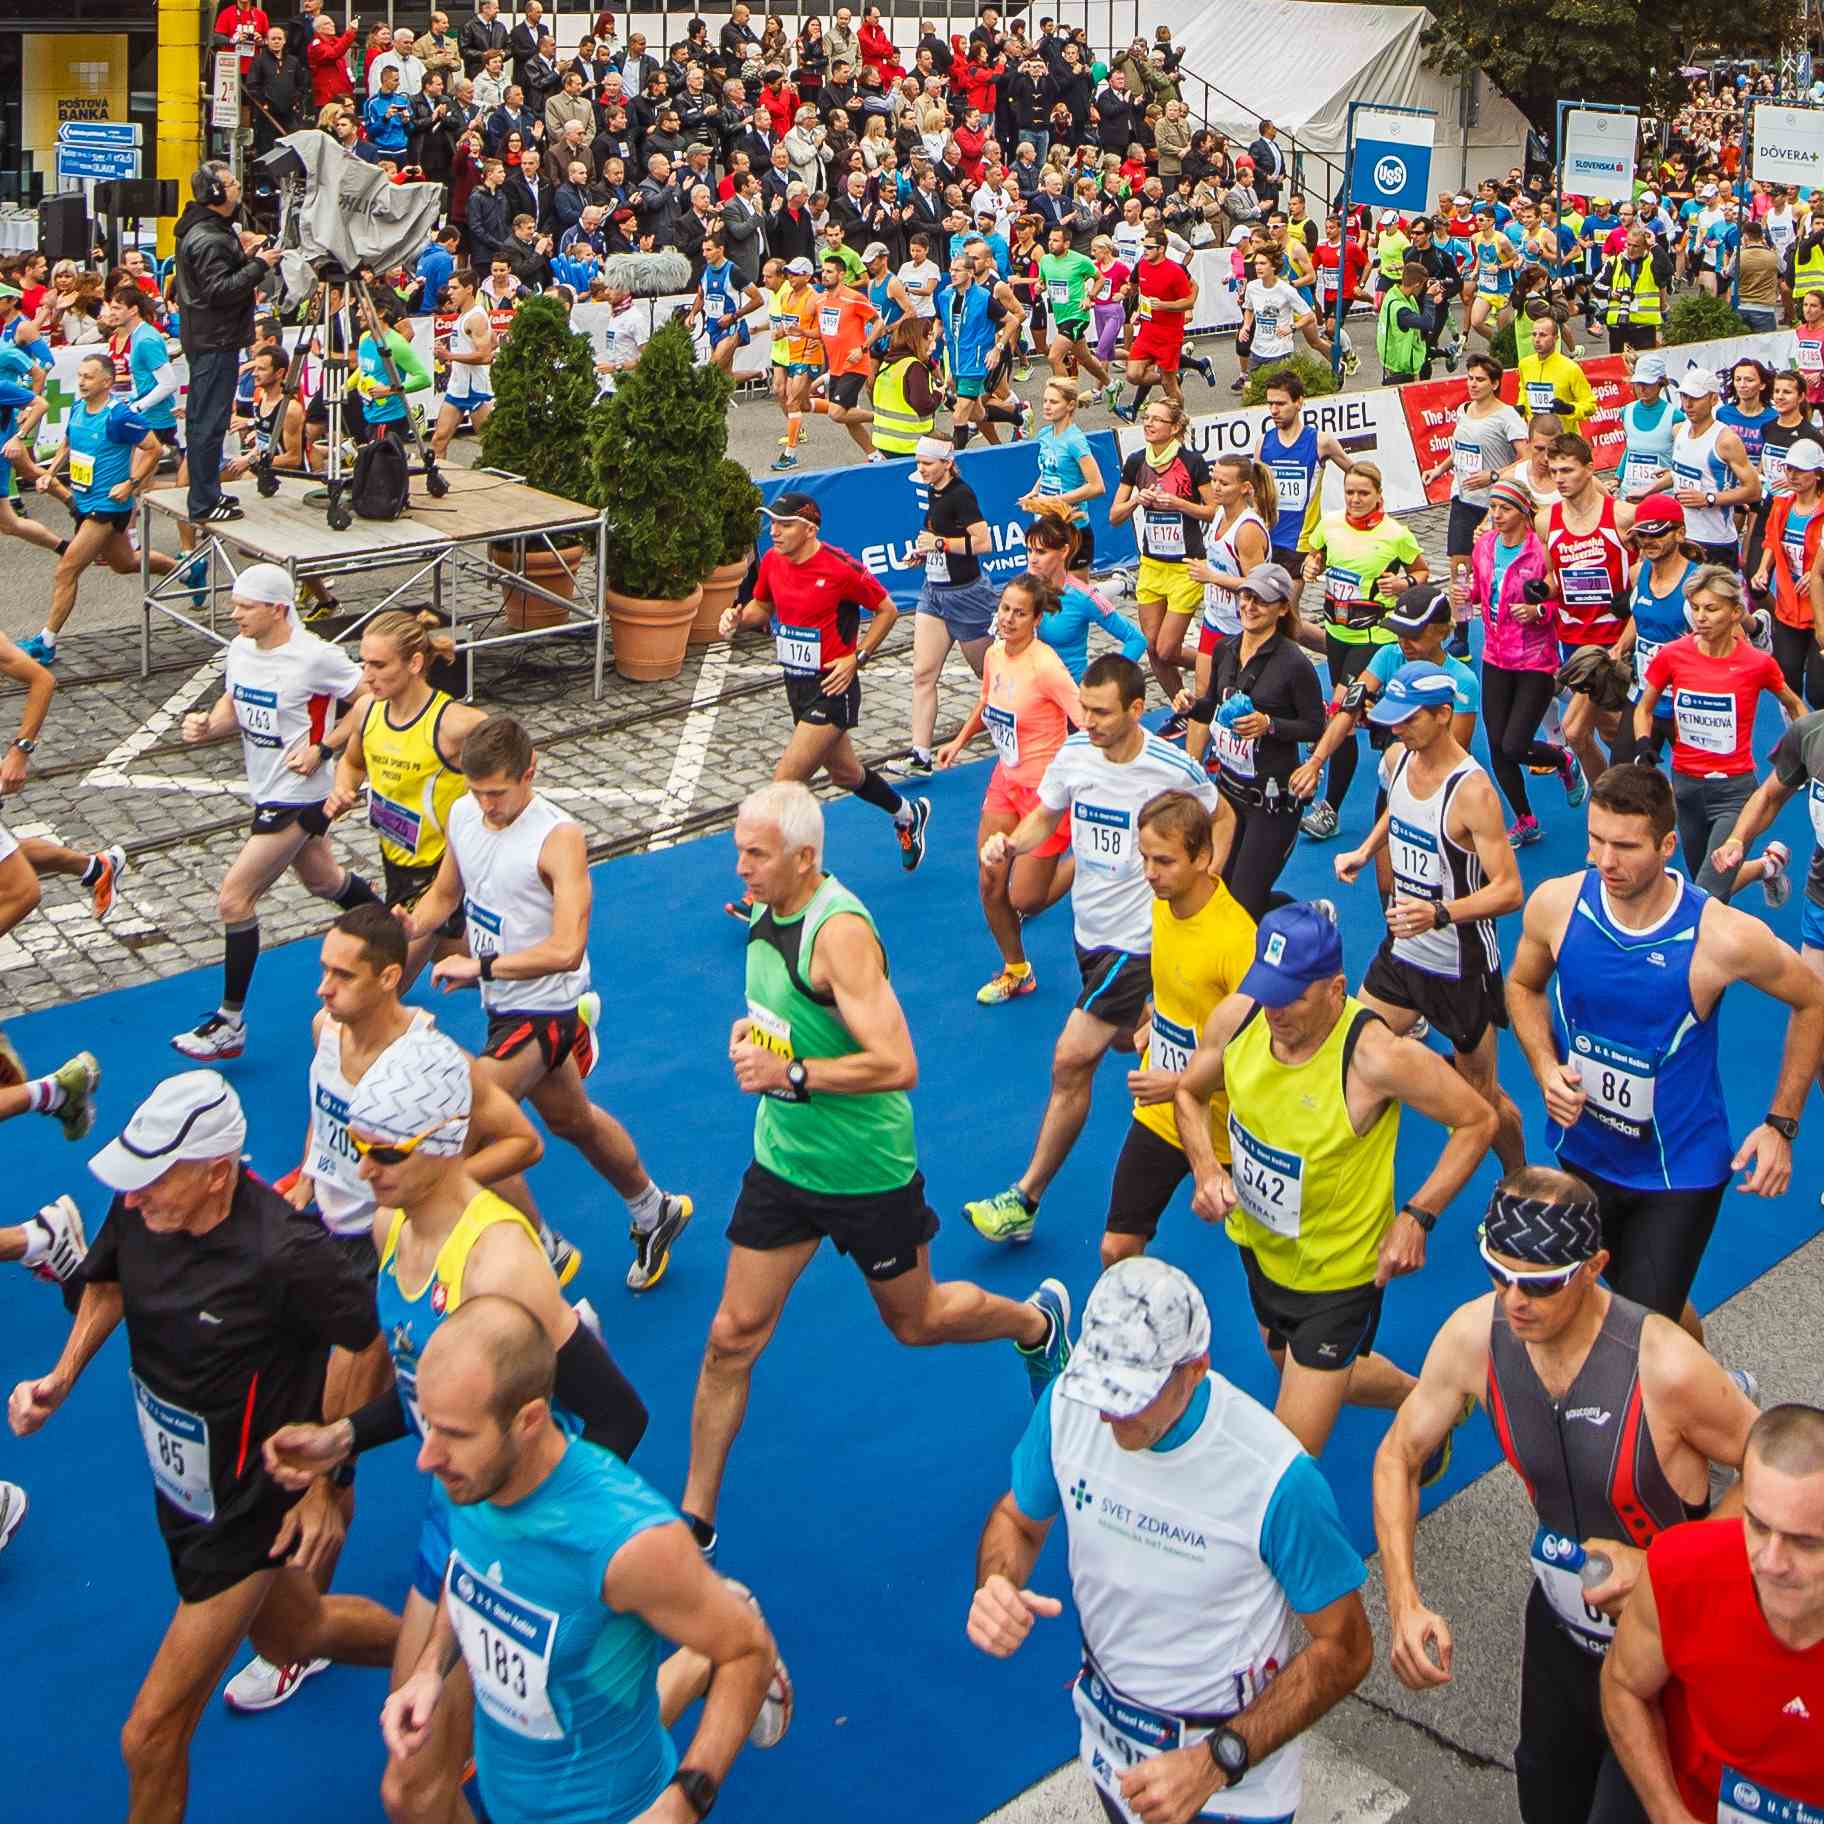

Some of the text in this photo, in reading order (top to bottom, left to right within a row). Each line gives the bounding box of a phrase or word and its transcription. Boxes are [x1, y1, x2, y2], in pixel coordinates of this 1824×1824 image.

[58, 108, 110, 121] BANKA
[1760, 145, 1810, 161] DÔVERA
[1422, 409, 1444, 426] The
[1279, 482, 1301, 496] 218
[1153, 526, 1180, 541] F176
[789, 642, 812, 664] 176
[1091, 826, 1122, 856] 158
[1401, 845, 1429, 877] 112
[1601, 1070, 1633, 1110] 86
[1242, 1157, 1286, 1207] 542
[156, 1425, 186, 1476] 85
[1100, 1497, 1131, 1526] SVET
[1136, 1516, 1209, 1552] ZDRAVIA
[479, 1627, 527, 1701] 183
